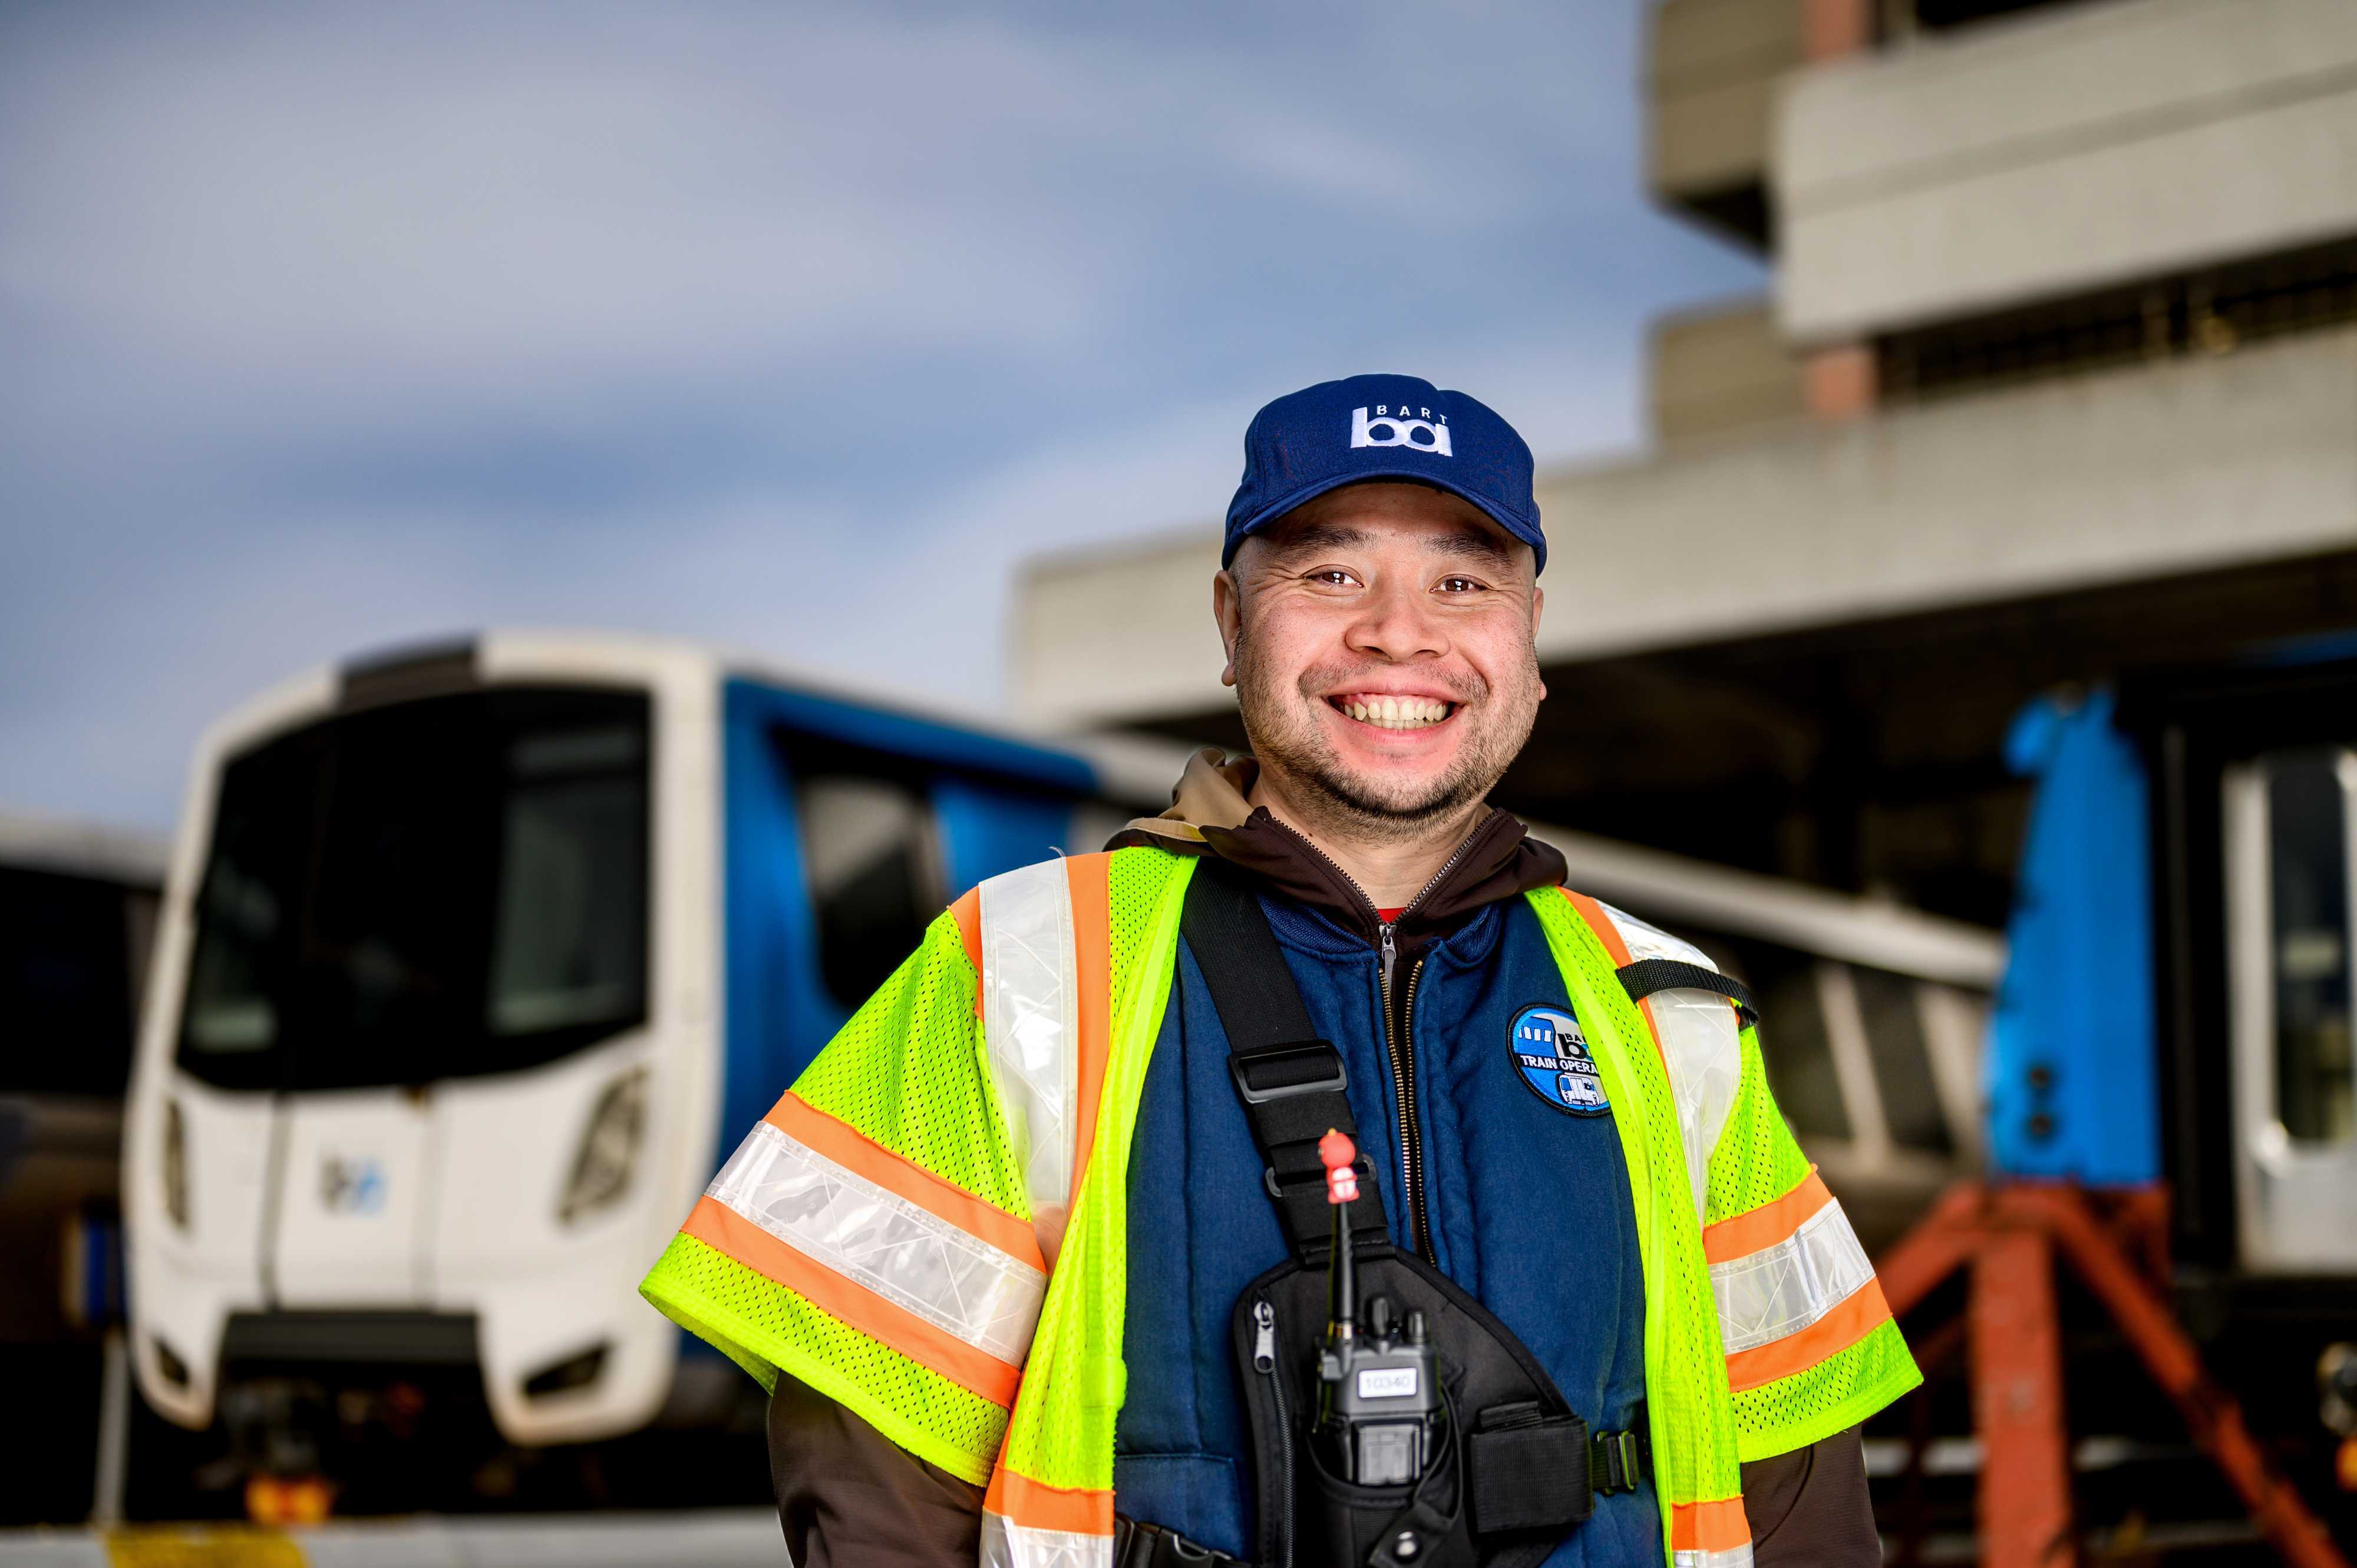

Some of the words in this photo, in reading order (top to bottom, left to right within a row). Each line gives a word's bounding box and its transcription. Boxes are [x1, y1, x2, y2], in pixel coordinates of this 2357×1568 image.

[1376, 405, 1447, 424] BART
[1520, 1055, 1557, 1069] TRAIN
[1560, 1059, 1599, 1074] OPERA
